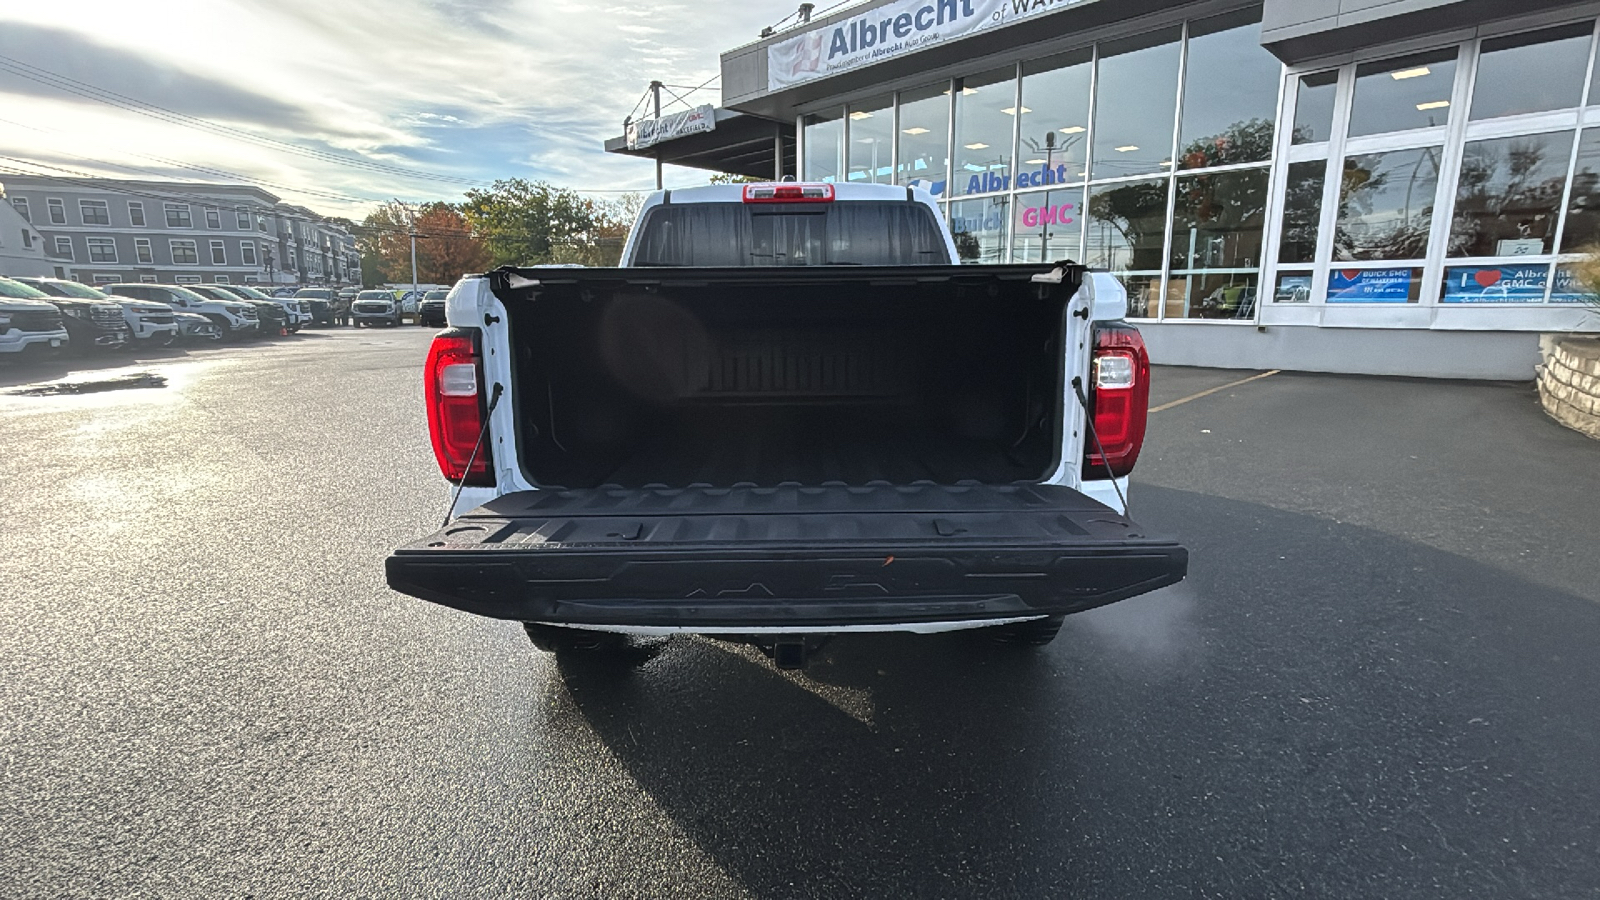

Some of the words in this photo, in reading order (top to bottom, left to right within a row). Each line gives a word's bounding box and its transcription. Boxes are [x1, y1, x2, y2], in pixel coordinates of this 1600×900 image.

[992, 3, 1007, 21] of
[828, 0, 974, 60] Albrecht
[872, 43, 902, 58] Albrecht
[967, 163, 1067, 194] Albrecht
[954, 211, 1002, 233] Buick
[1022, 203, 1074, 227] GMC
[1362, 270, 1387, 278] BUICK
[1389, 269, 1408, 277] GMC
[1461, 272, 1468, 287] I
[1514, 269, 1571, 279] Albreht
[1501, 279, 1534, 288] GMC
